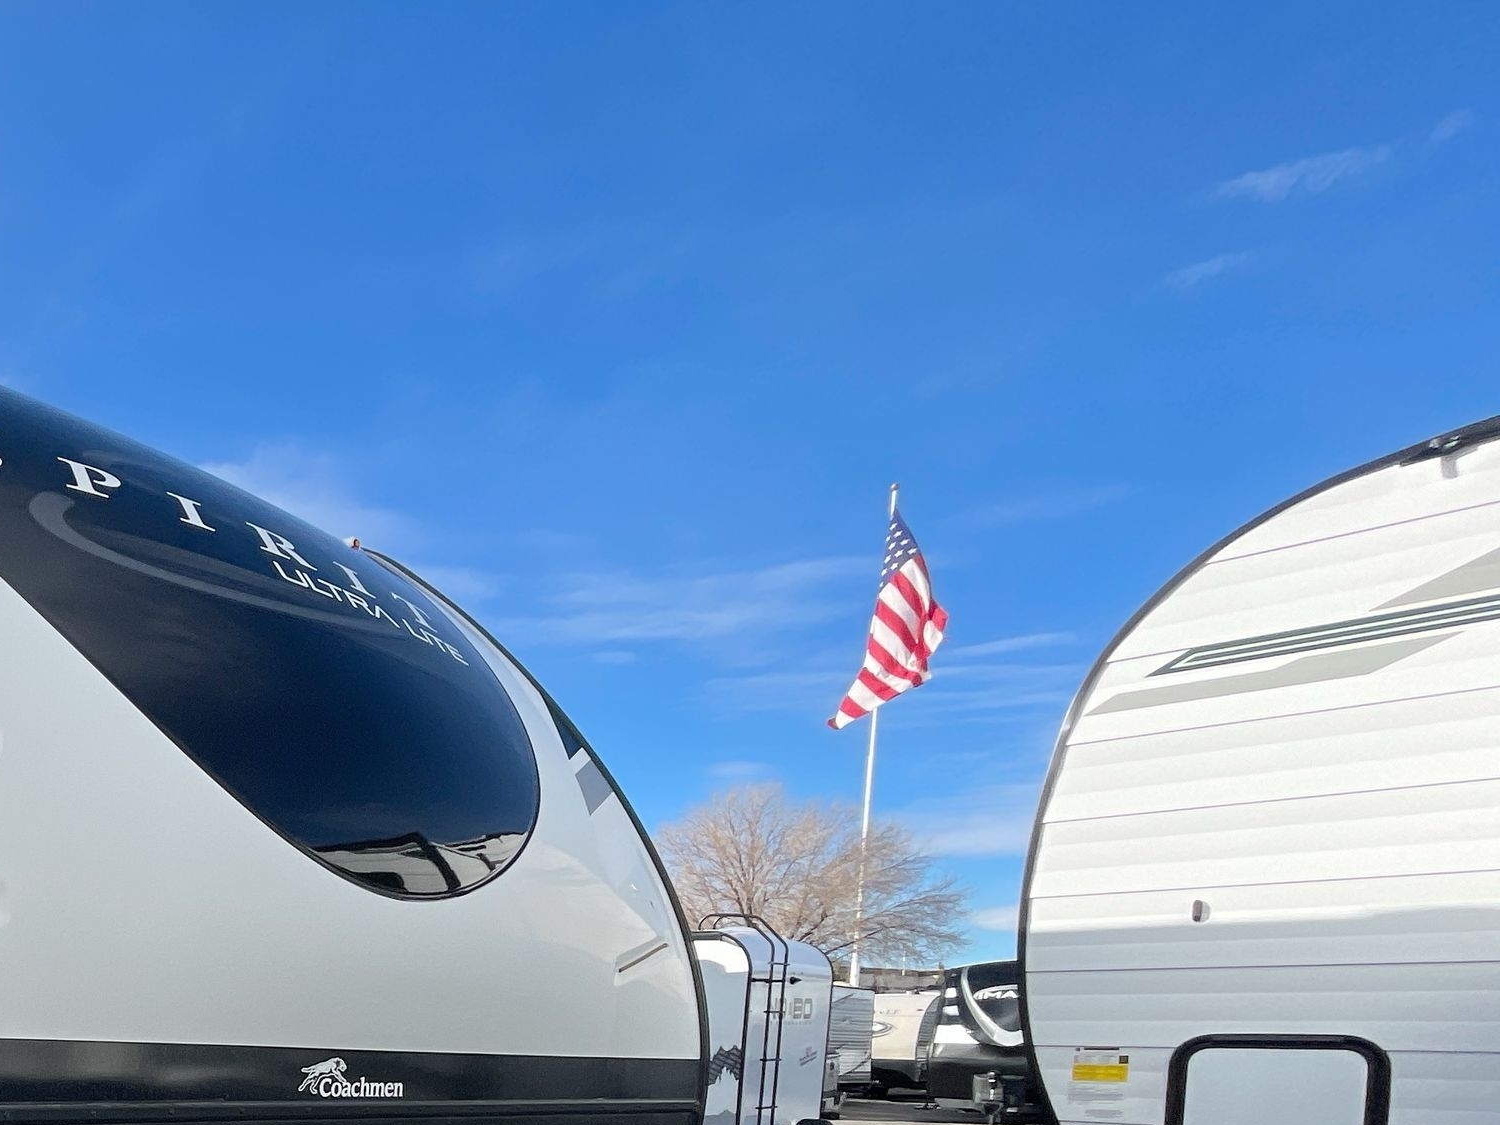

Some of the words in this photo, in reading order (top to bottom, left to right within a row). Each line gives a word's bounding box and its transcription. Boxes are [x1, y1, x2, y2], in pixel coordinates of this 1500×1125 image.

[273, 561, 401, 628] ULTRA
[402, 618, 470, 667] LITE
[319, 1076, 404, 1098] Coachmen
